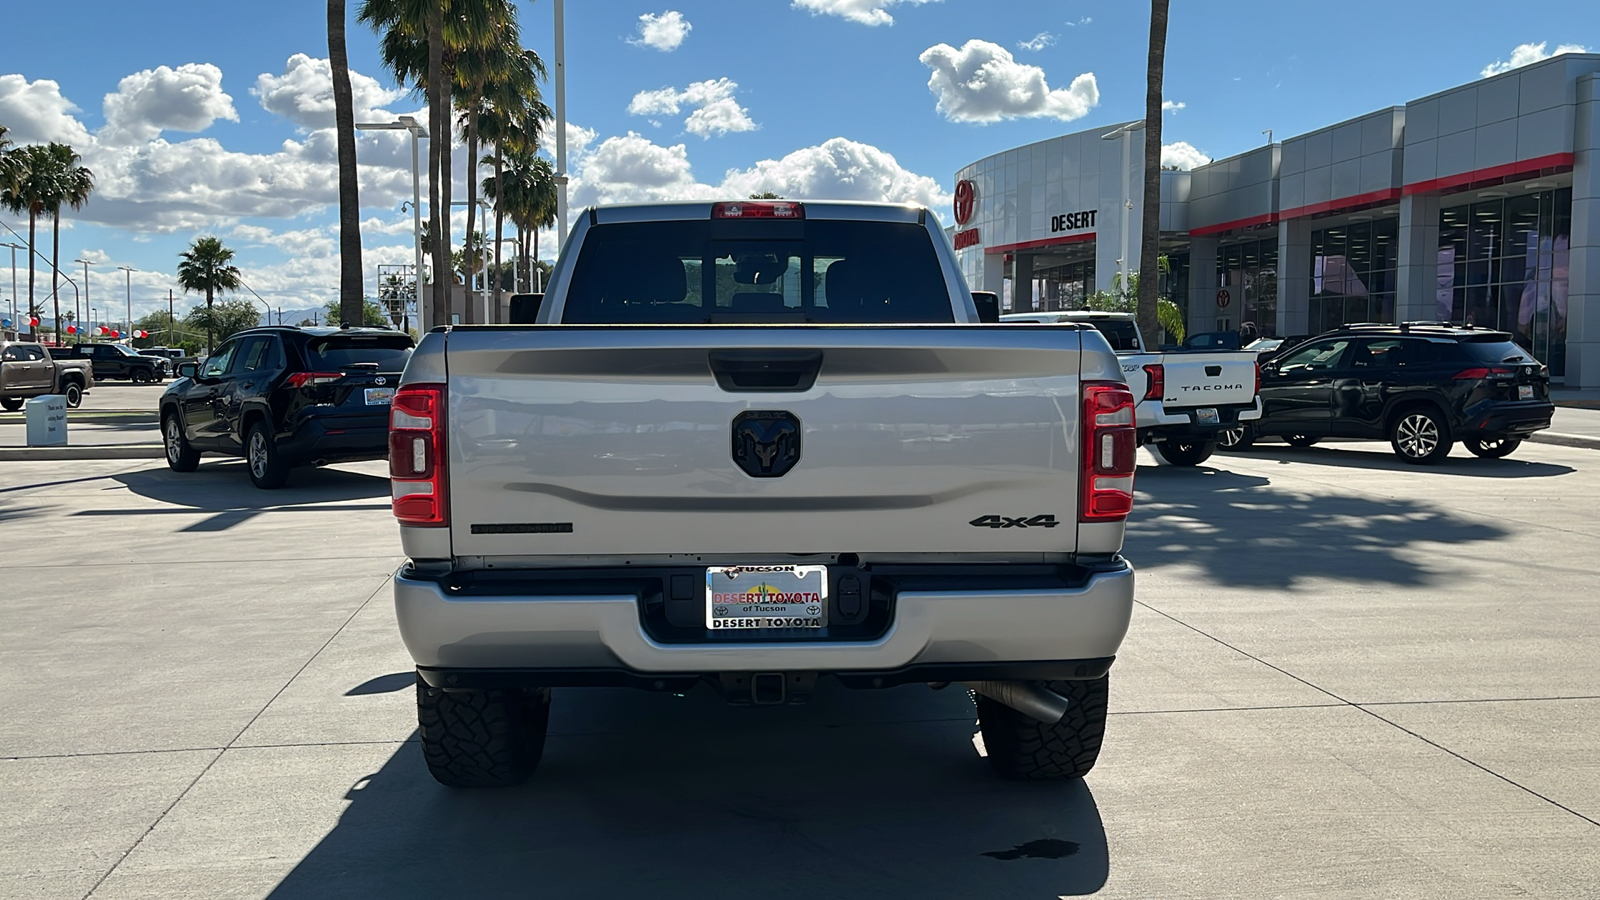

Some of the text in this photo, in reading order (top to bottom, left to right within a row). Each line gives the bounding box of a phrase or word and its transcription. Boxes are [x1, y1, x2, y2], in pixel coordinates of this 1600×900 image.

[1051, 210, 1097, 232] DESERT
[953, 228, 980, 250] TOYOTA
[969, 515, 1060, 528] 4x4
[714, 593, 820, 604] DESERT TOYOTA
[713, 619, 820, 628] DESERT TOYOTA
